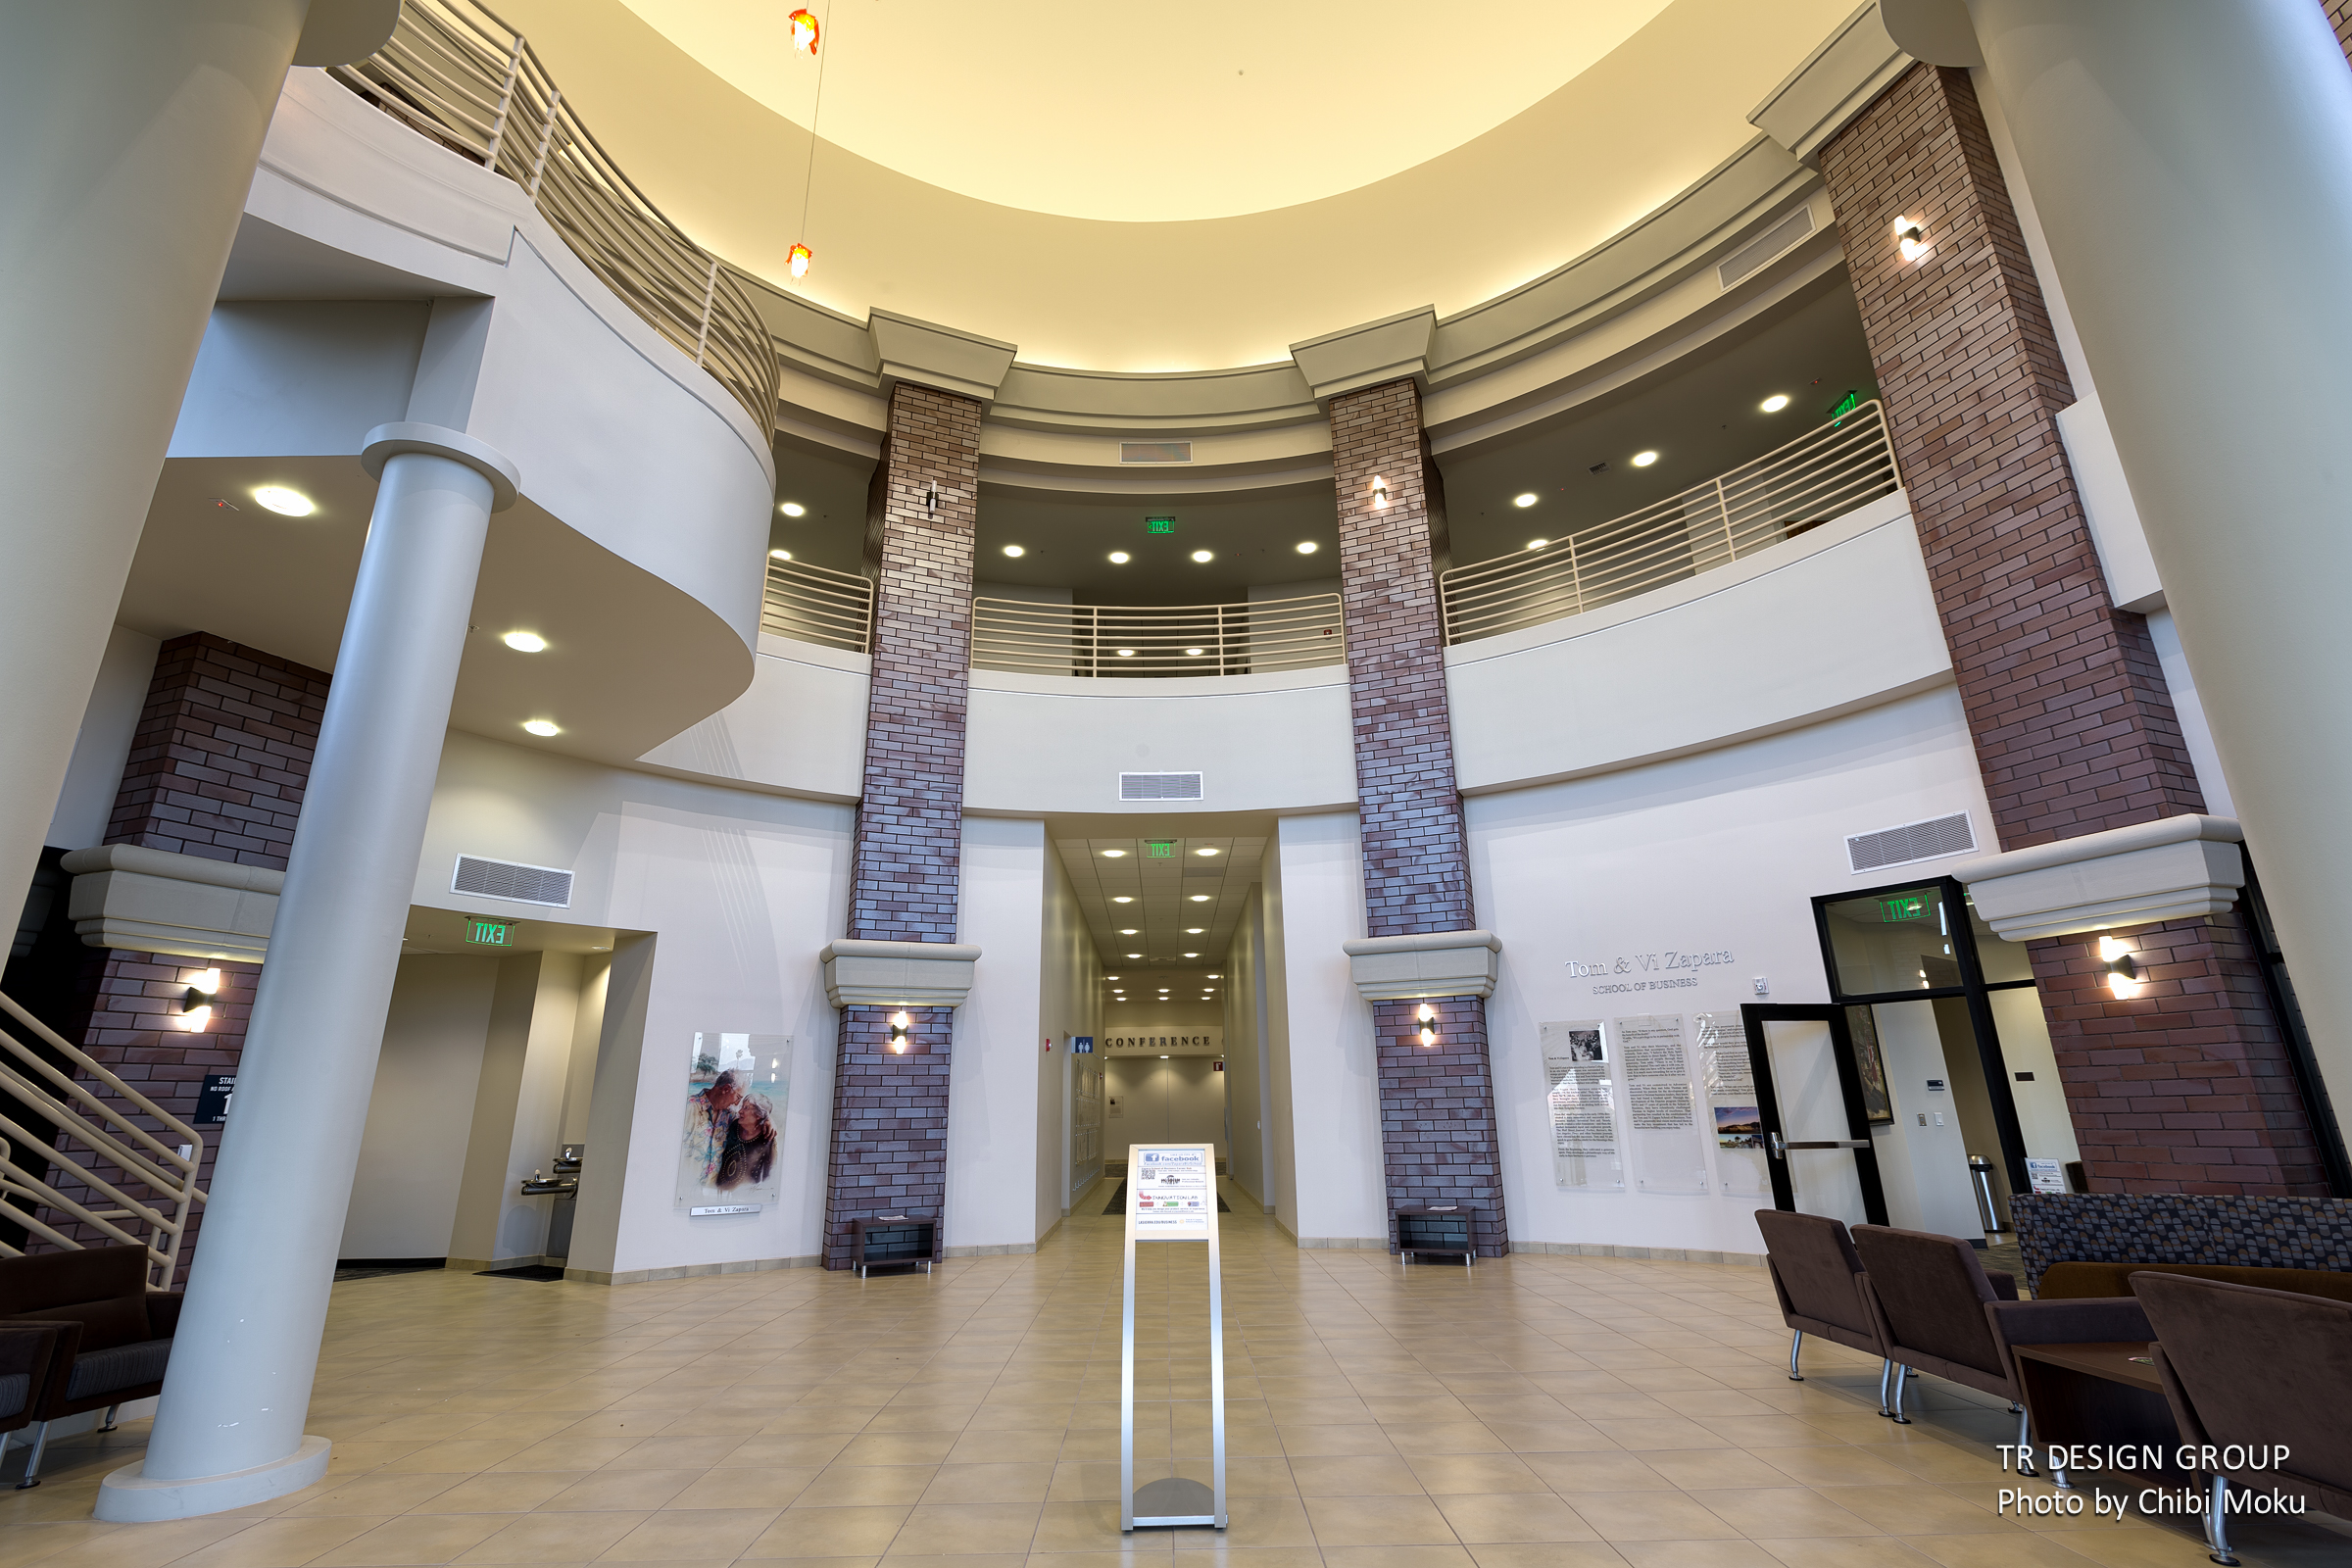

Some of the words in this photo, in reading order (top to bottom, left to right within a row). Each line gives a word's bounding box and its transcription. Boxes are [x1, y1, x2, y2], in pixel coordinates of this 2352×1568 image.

[1564, 960, 1609, 978] Tom
[1613, 956, 1632, 974] &
[1635, 953, 1660, 972] Vi
[1664, 950, 1735, 972] Zapara
[1592, 983, 1633, 995] SCHOOL
[1634, 981, 1646, 991] OF
[1648, 977, 1698, 990] BUSINESS
[1104, 1036, 1210, 1048] CONFERENCE
[223, 1094, 232, 1114] 1
